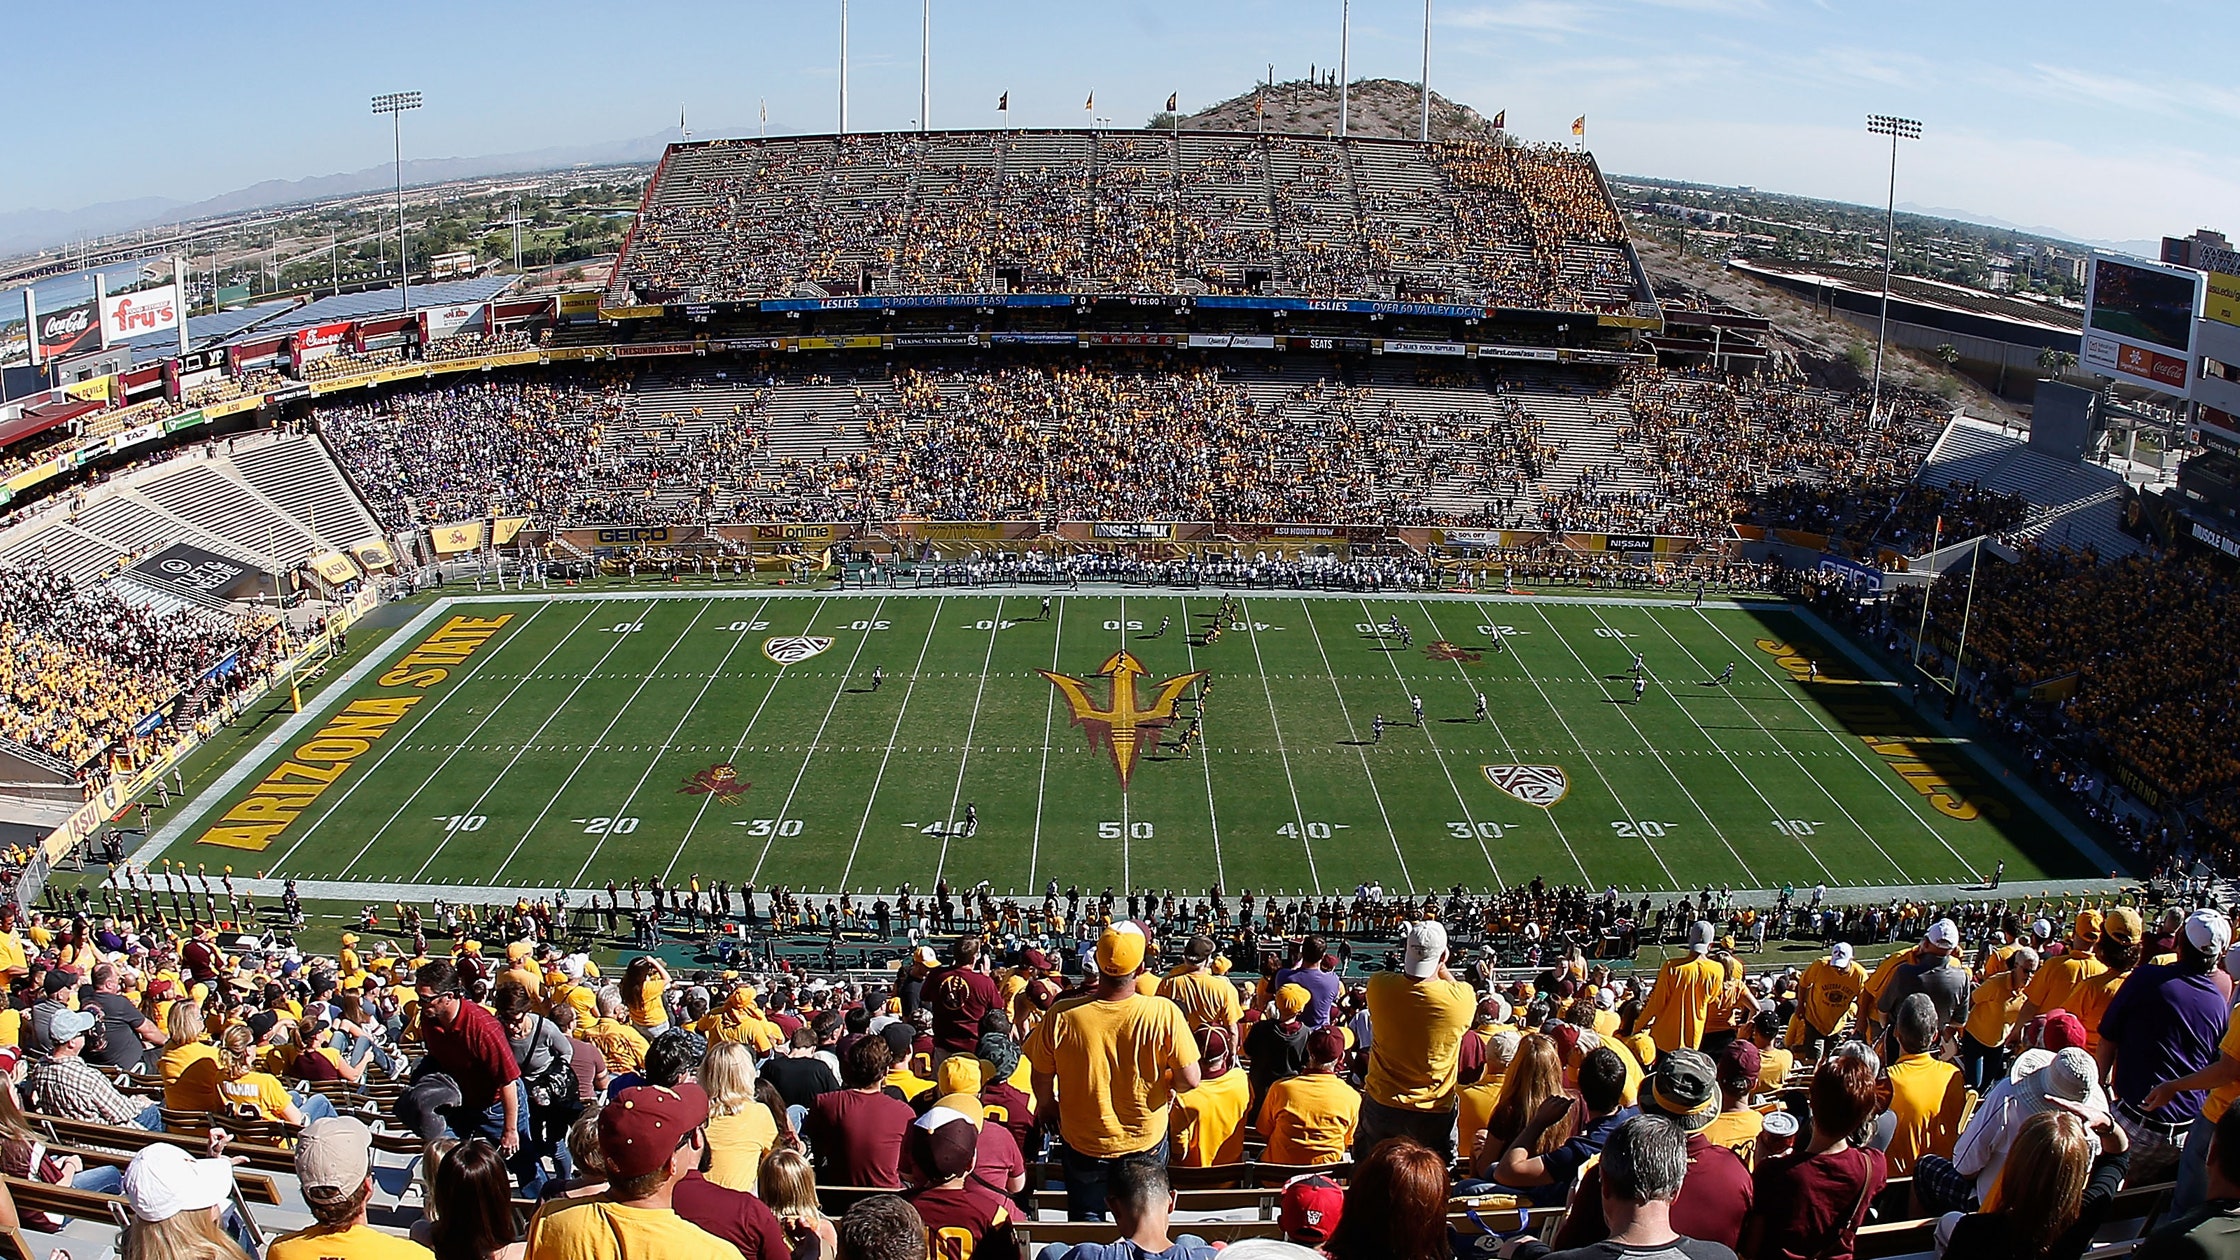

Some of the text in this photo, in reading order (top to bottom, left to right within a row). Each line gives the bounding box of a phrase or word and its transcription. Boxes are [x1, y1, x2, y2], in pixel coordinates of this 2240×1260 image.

[893, 297, 920, 306] POOL
[924, 296, 948, 306] CARE
[951, 296, 980, 306] MADE
[983, 296, 1008, 306] EASY
[1080, 296, 1087, 305] 0
[1138, 298, 1160, 306] 15:00
[1181, 297, 1187, 306] 0
[1372, 303, 1398, 313] OVER
[1401, 304, 1413, 314] 60
[1415, 305, 1449, 315] VALLEY
[618, 344, 692, 355] THESUNDEVILS.COM
[1310, 339, 1332, 349] SEATS
[227, 404, 240, 413] ASU
[2207, 439, 2222, 449] Listen
[598, 528, 668, 543] GEICO
[757, 525, 829, 538] ASU online
[1095, 524, 1169, 537] MUSCLE MILK
[1274, 527, 1333, 536] ASU HONOR ROW
[2192, 522, 2220, 548] MUSCLE
[1610, 539, 1649, 548] NISSAN
[326, 561, 347, 576] ASU
[612, 622, 645, 633] 10
[733, 621, 770, 632] 20
[851, 620, 890, 632] 30
[975, 620, 1017, 631] 40
[1102, 620, 1143, 632] 50
[1232, 621, 1269, 632] 40
[1593, 627, 1627, 638] 10
[377, 613, 517, 688] STATE
[194, 695, 424, 852] ARIZONA
[2117, 763, 2159, 807] INFERNO
[73, 805, 97, 838] ASU
[445, 815, 488, 832] 10
[582, 816, 640, 835] 20
[746, 817, 803, 837] 30
[1098, 821, 1155, 839] 50
[1276, 821, 1332, 840] 40
[1446, 821, 1504, 839] 30
[1610, 820, 1666, 838] 20
[1770, 819, 1815, 837] 10
